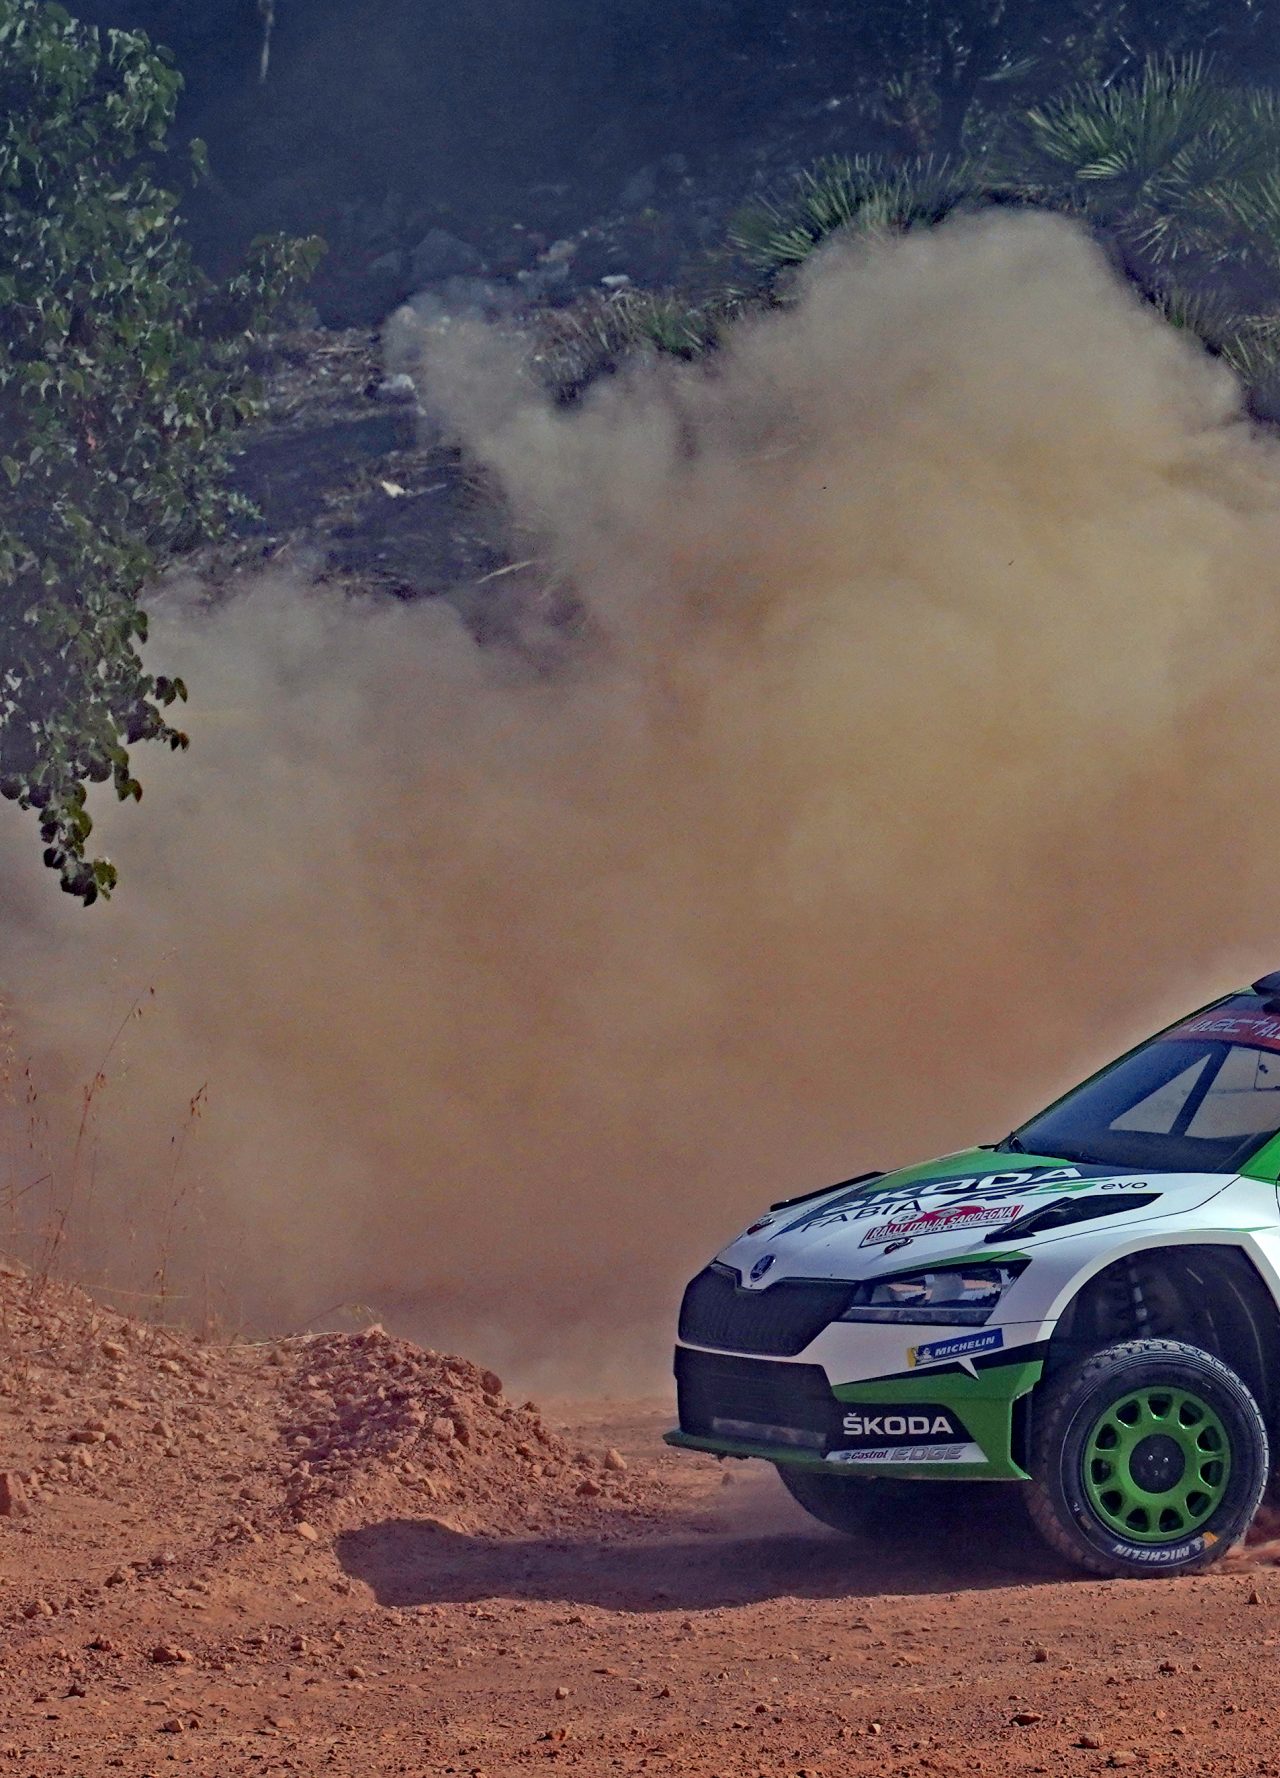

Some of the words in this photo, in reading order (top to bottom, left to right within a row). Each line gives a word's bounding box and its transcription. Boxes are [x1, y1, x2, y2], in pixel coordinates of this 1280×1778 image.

[1101, 1181, 1148, 1190] evo
[800, 1200, 921, 1232] FABIA
[870, 1222, 908, 1239] RALLY
[909, 1217, 946, 1232] ITALIA
[948, 1206, 1013, 1225] SARDEGNA
[935, 1336, 995, 1356] MICHELIN
[843, 1412, 954, 1435] ŠKODA
[851, 1449, 888, 1460] Castrol
[890, 1445, 967, 1461] EDGE
[1112, 1543, 1190, 1561] MICHELIN
